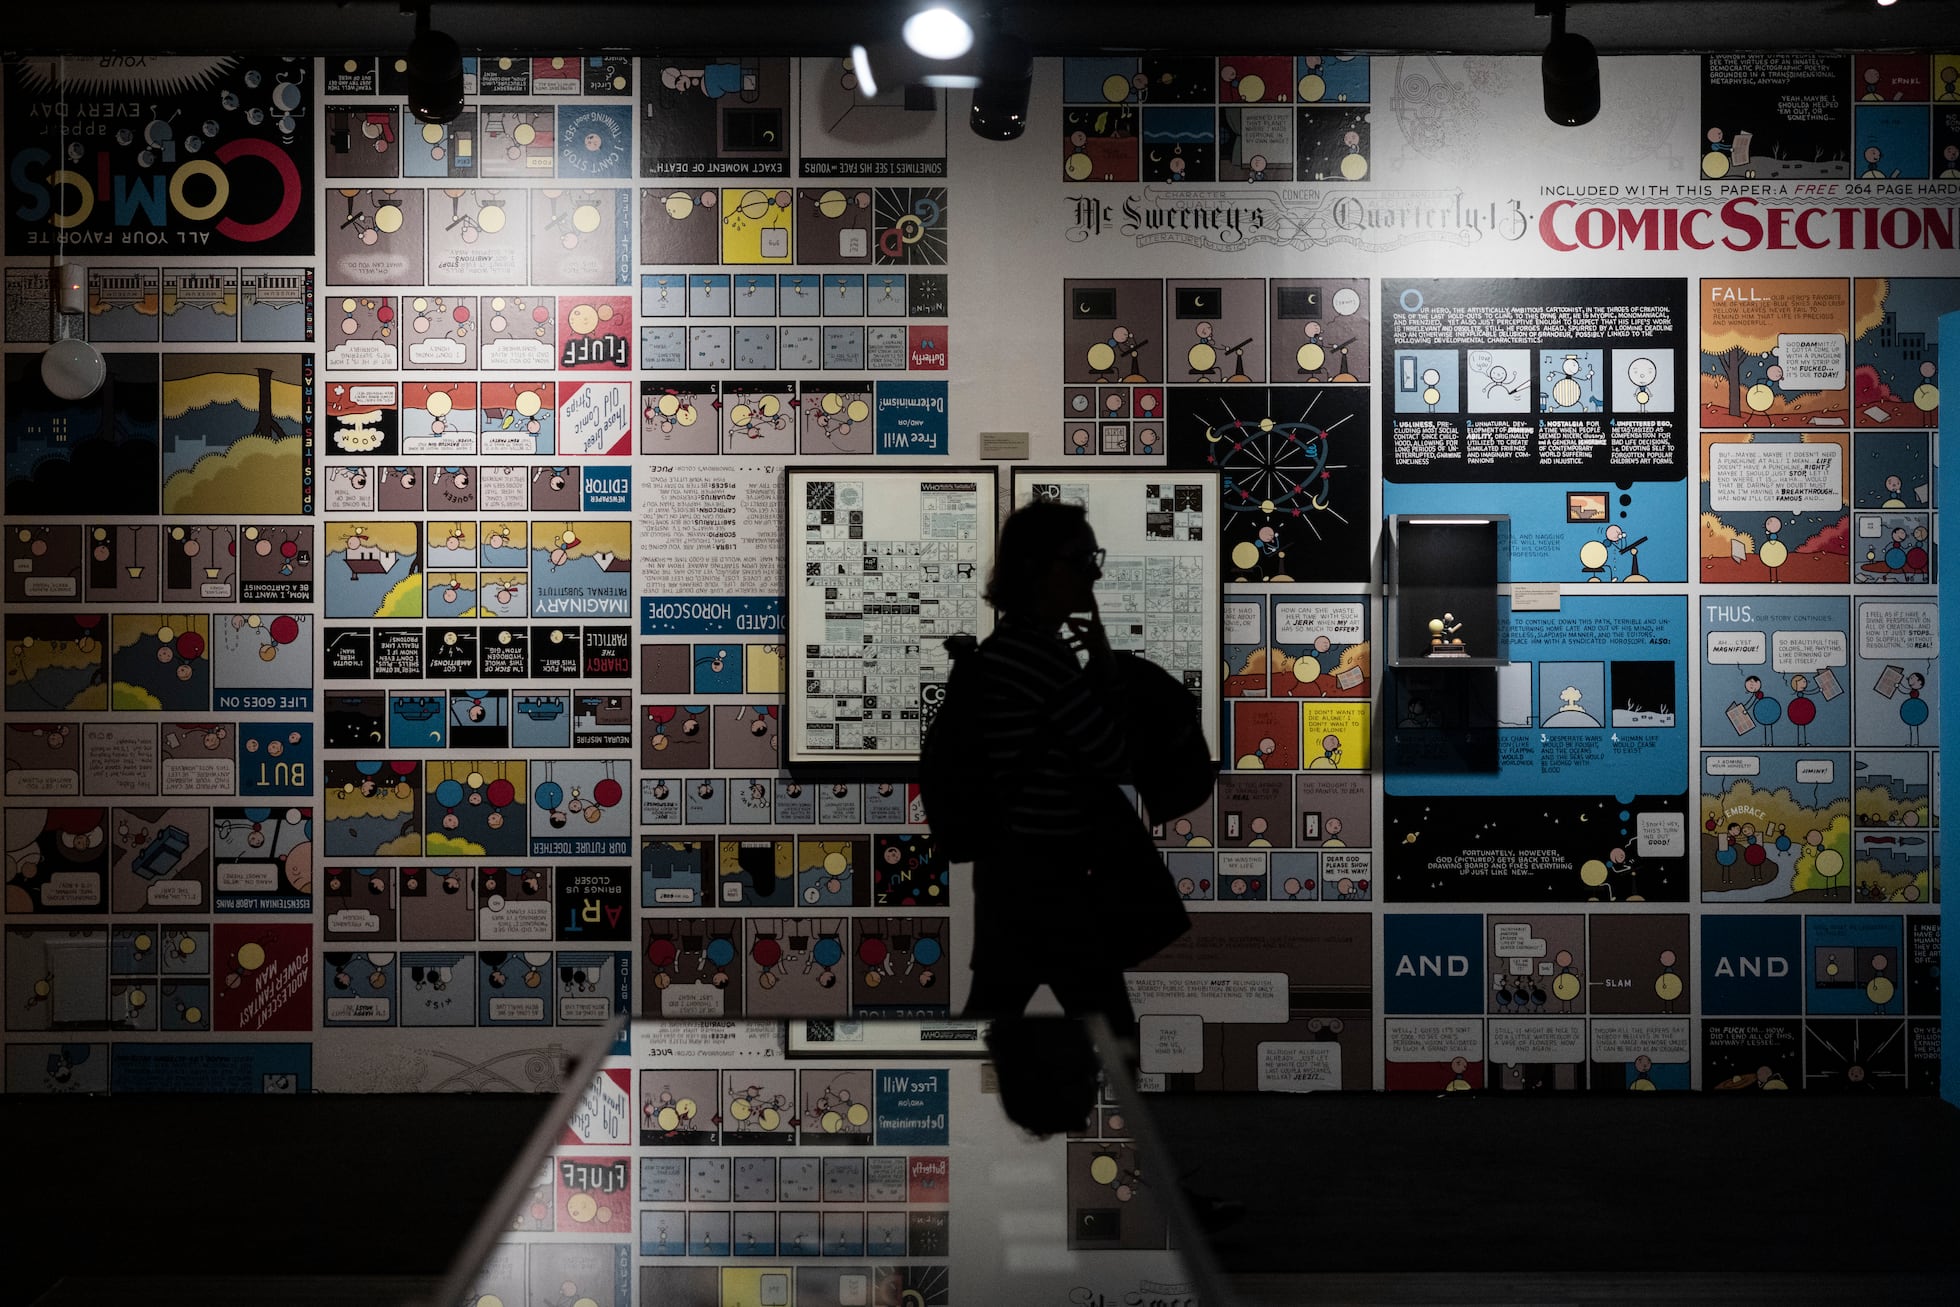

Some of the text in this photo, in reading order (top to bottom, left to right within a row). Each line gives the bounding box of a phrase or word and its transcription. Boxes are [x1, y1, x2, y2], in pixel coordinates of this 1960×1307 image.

[590, 81, 611, 90] Circle
[29, 102, 140, 116] EVERY DAY
[573, 114, 590, 126] about
[591, 112, 622, 138] THINKING
[564, 125, 575, 142] SEX
[564, 149, 587, 171] STOP
[591, 152, 619, 173] CAN'T
[691, 162, 704, 172] OF
[707, 162, 749, 172] MOMENT
[753, 162, 782, 172] EXACT
[804, 162, 832, 173] YOURS
[839, 162, 858, 173] FACE
[859, 162, 872, 173] HIS
[874, 162, 888, 173] SEE
[898, 162, 942, 173] SOMETIMES
[10, 137, 302, 242] COMICS
[1282, 190, 1320, 200] CONCERN
[1540, 186, 1712, 196] INCLUDED WITH THIS
[1795, 185, 1839, 194] FREE
[1845, 185, 1871, 194] 264
[1877, 185, 1913, 194] PAGE
[1121, 195, 1264, 243] Sweeney's
[1539, 200, 1715, 251] COMIC
[880, 199, 940, 256] GOD
[122, 231, 168, 245] YOUR
[177, 231, 210, 245] ALL
[561, 335, 626, 365] FLUFF
[911, 350, 945, 366] Butterfly
[565, 387, 592, 417] Strips
[879, 396, 944, 412] Determinism?
[574, 387, 619, 433] Old Comic
[303, 357, 313, 513] OPPOSITES ATTRACT
[584, 404, 627, 452] Those Great
[341, 434, 376, 445] BOOM
[883, 432, 937, 448] Free Will
[649, 465, 673, 473] PUCE.
[585, 478, 628, 493] EDITOR
[590, 495, 625, 503] NEWSPAPER
[244, 583, 309, 591] BE A CARTOONIST
[537, 587, 627, 597] PATERNAL SUBSTITUTE
[243, 590, 310, 600] MOM, I WANT TO
[535, 598, 628, 613] IMAGINARY
[648, 602, 731, 618] HOROSCOPE
[586, 632, 628, 647] PARTICLE
[601, 649, 615, 657] THE
[1713, 645, 1759, 653] MAGNIFIQUE!
[586, 657, 629, 672] CHARGY
[220, 696, 307, 708] LIFE GOES ON
[577, 735, 630, 743] NEURAL MISFIRE
[256, 762, 305, 787] BUT
[1724, 804, 1766, 820] EMBRACE
[533, 841, 627, 853] OUR FUTURE TOGETHER
[1454, 856, 1496, 864] (PICTURED)
[1531, 862, 1573, 870] EVERYTHING
[574, 876, 610, 885] CLOSER
[216, 899, 310, 908] EISENSTEINIAN LABOR PAINS
[564, 899, 623, 932] ART
[1395, 955, 1469, 977] AND
[1714, 956, 1789, 978] AND
[254, 960, 277, 992] MAN
[1605, 979, 1632, 987] SLAM
[239, 947, 309, 1028] POWER FANTASY
[255, 967, 308, 1030] ADOLESCENT
